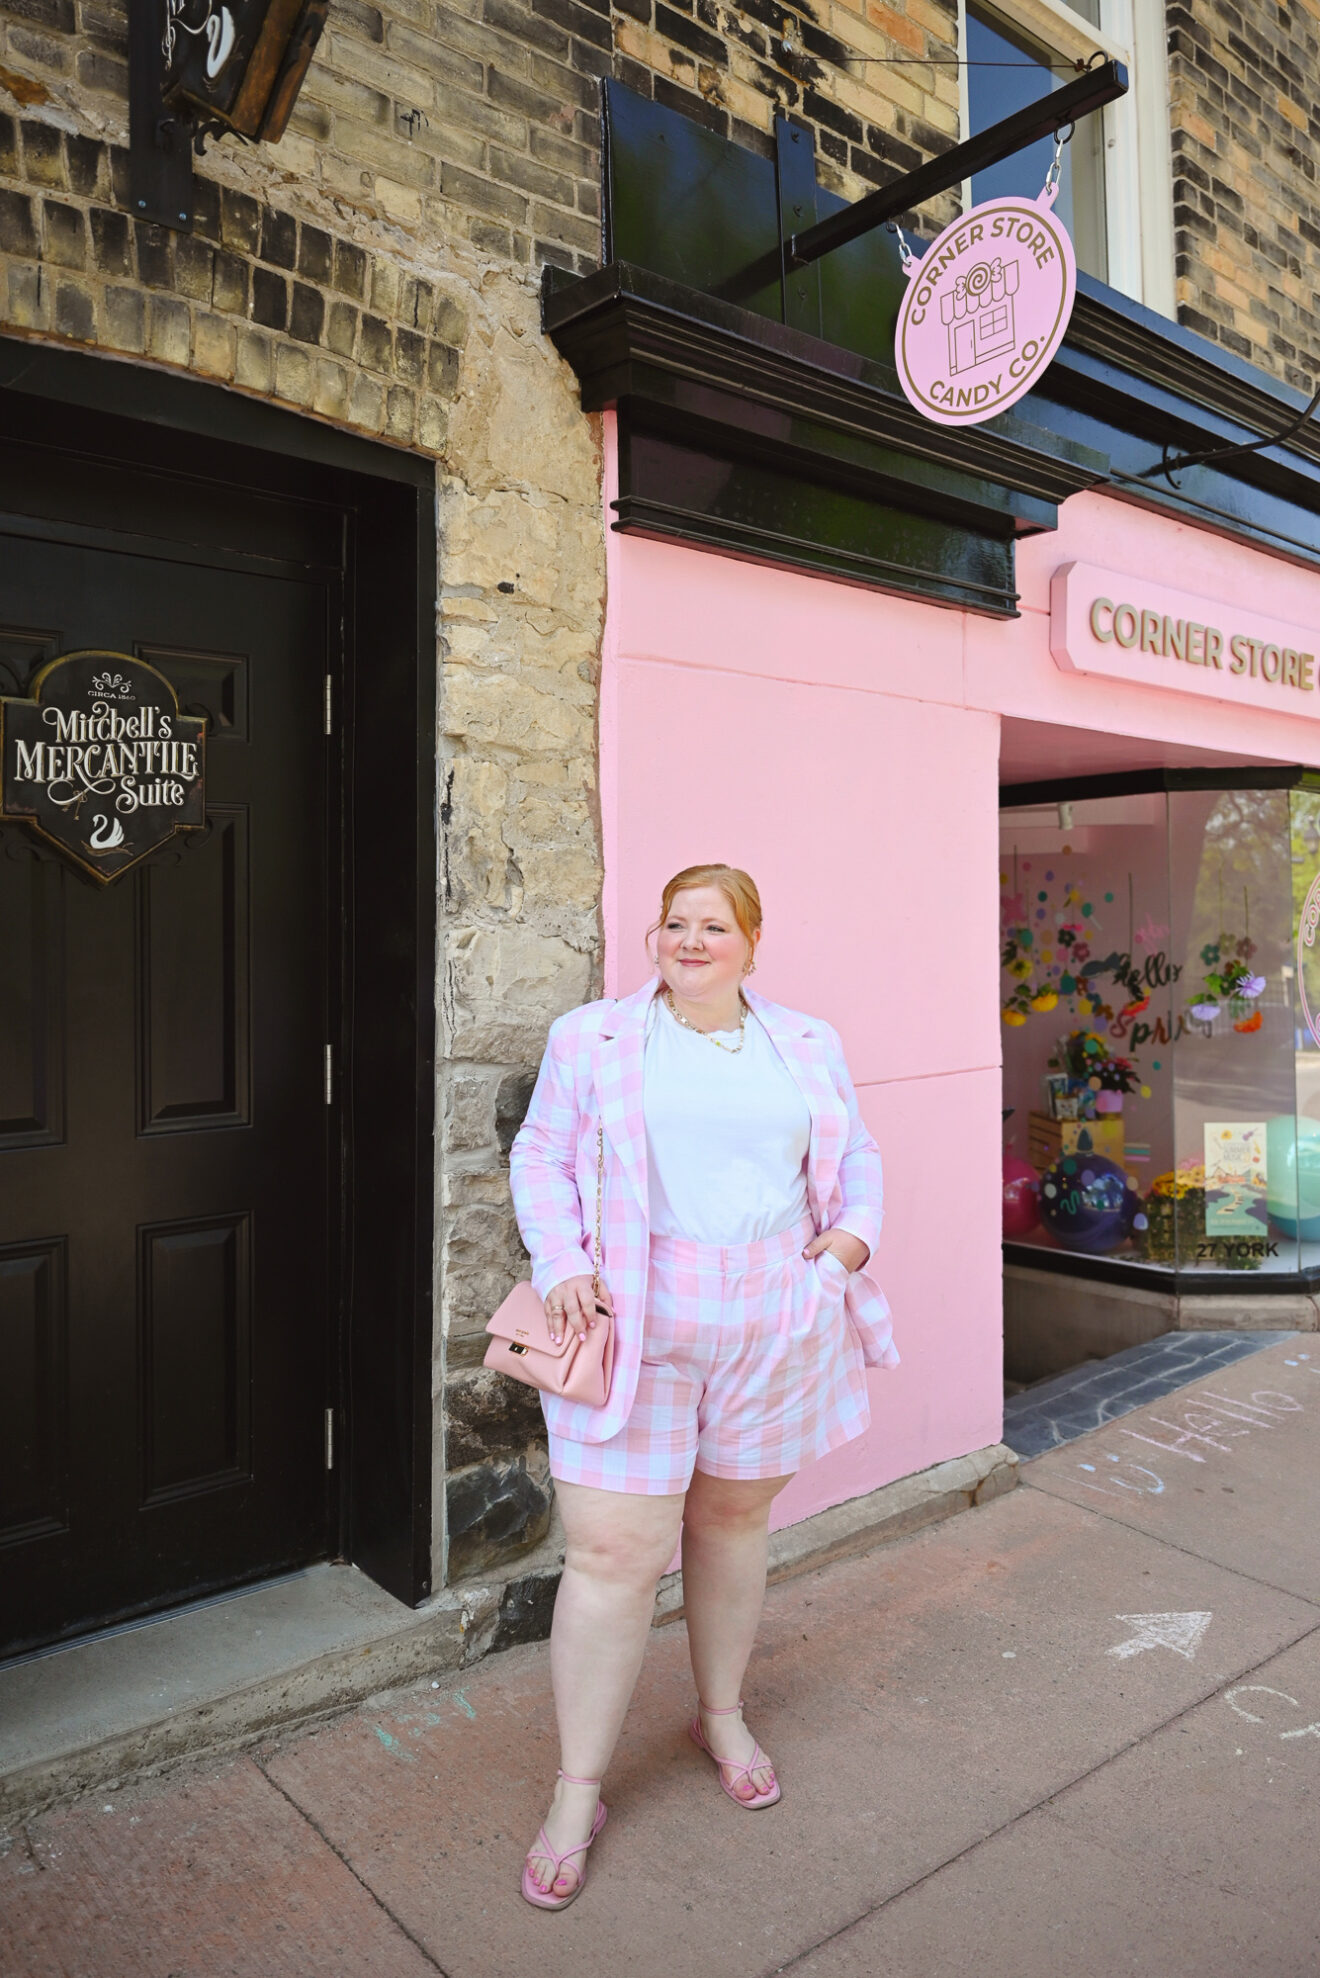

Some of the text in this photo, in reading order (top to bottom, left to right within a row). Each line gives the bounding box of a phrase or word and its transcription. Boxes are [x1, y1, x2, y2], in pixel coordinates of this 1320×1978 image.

[910, 216, 1056, 326] CORNER STORE
[929, 335, 1046, 408] CANDY CO.
[1089, 596, 1315, 691] CORNER STORE
[87, 690, 117, 699] CIRCA
[42, 700, 172, 744] Mitchell's
[13, 739, 200, 794] MERCANTILE
[115, 775, 185, 815] Suite
[1196, 1242, 1280, 1258] 27 YORK
